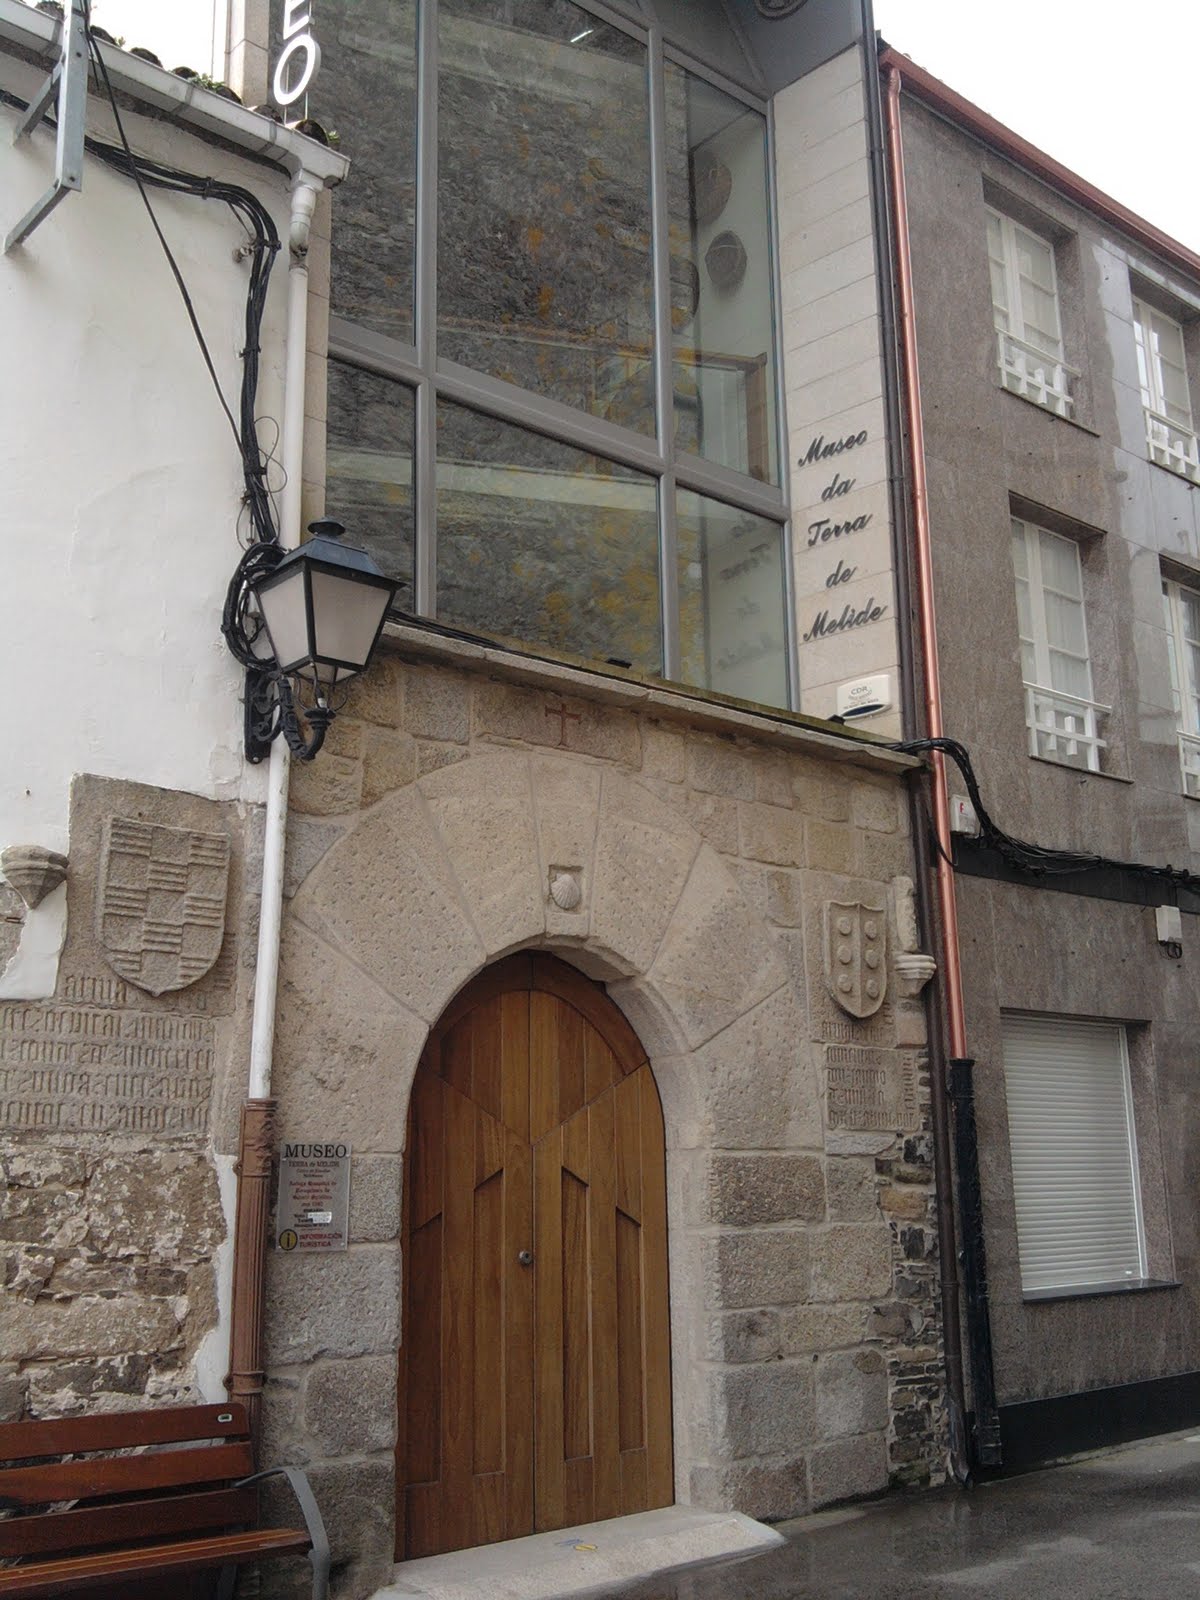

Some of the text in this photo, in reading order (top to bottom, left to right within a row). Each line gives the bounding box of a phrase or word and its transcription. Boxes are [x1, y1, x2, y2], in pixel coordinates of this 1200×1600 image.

[798, 429, 868, 467] Museo
[821, 473, 856, 502] da
[807, 514, 873, 547] Terra
[826, 560, 858, 588] de
[803, 597, 888, 642] Melide
[850, 686, 868, 697] CDR
[284, 1144, 347, 1158] MUSEO
